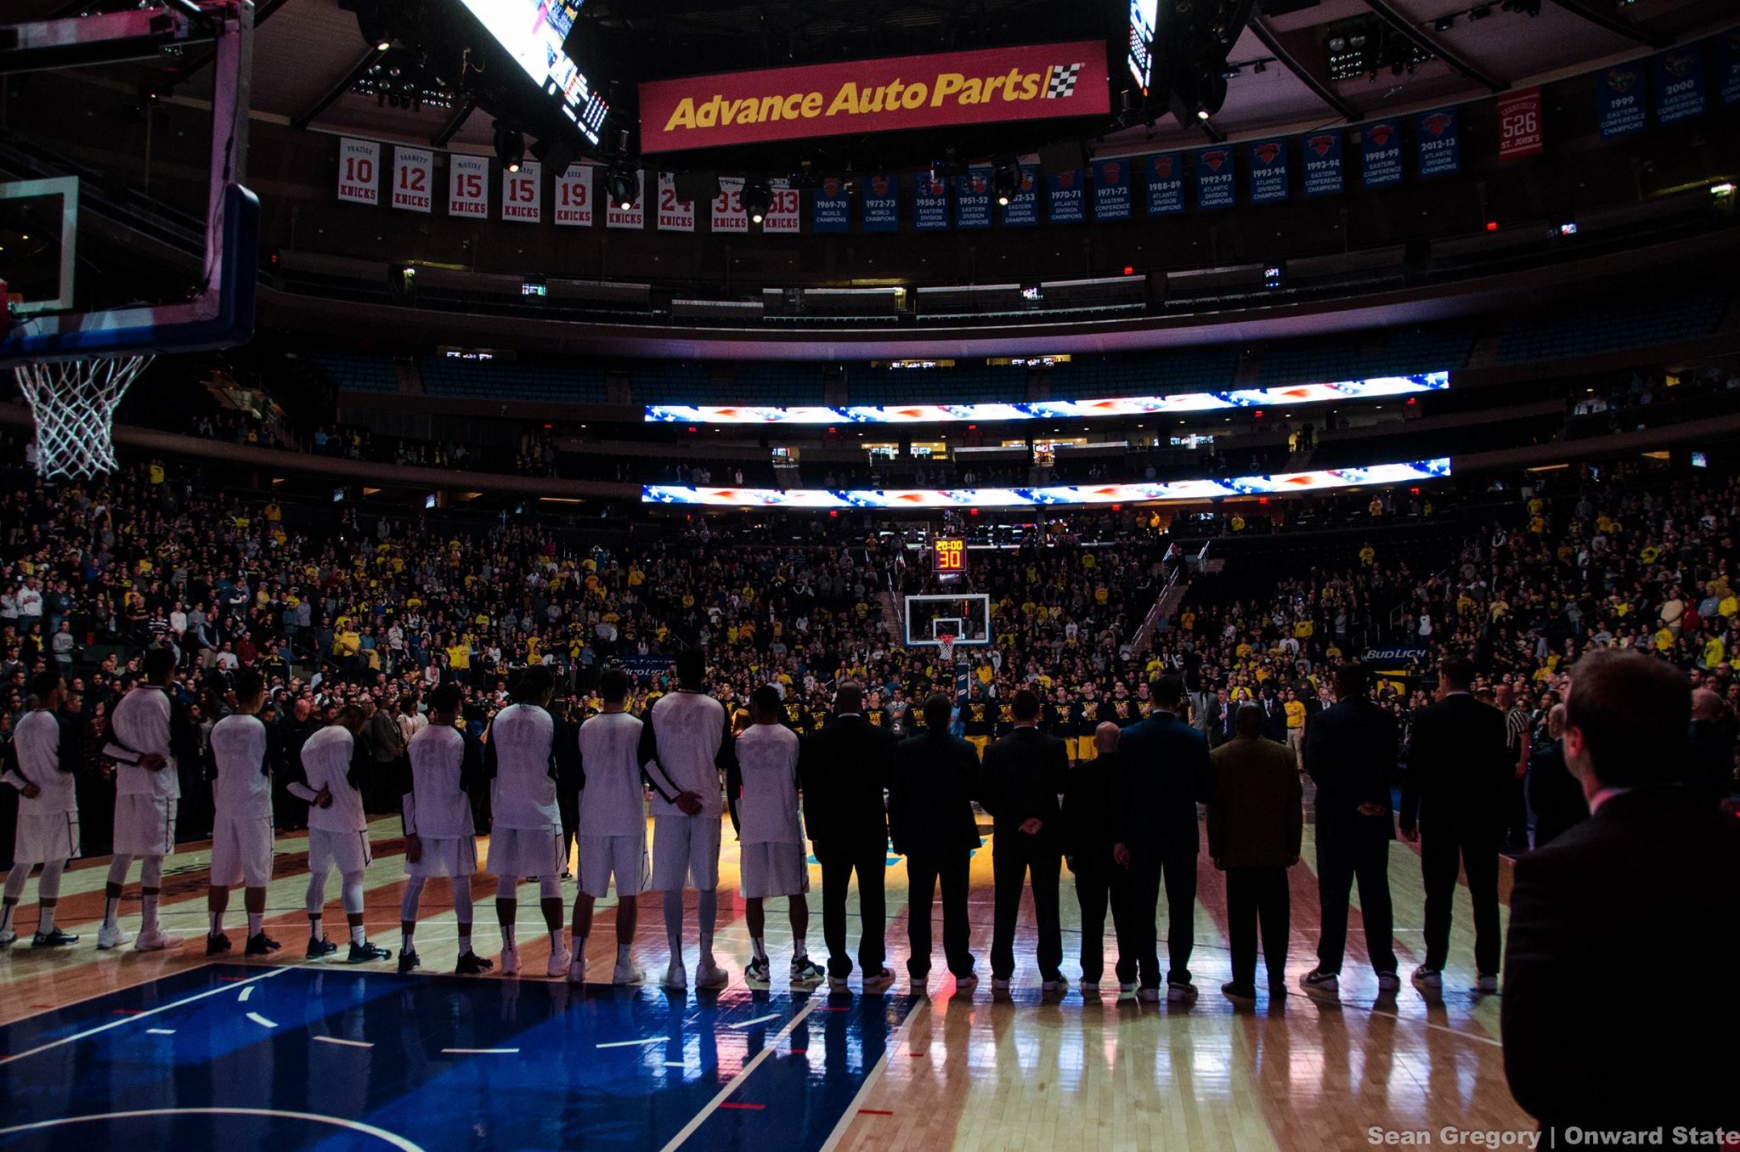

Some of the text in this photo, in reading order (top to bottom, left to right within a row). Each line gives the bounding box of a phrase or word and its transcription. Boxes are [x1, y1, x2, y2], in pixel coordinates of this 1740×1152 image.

[1666, 79, 1695, 95] 2000
[664, 68, 1041, 132] Advance Auto Parts
[1610, 95, 1635, 109] 1999
[1663, 91, 1697, 105] EASTERN
[1657, 96, 1705, 115] CONFERENCE
[1606, 107, 1639, 120] EASTERN
[1660, 105, 1703, 122] CHAMPIONS
[1503, 111, 1537, 138] 526
[1600, 112, 1646, 128] CONFERENCE
[1603, 121, 1644, 136] CHAMPIONS
[1421, 138, 1455, 151] 2012-13
[1514, 134, 1540, 146] JOHN'S
[1365, 148, 1399, 162] 1998-99
[1424, 149, 1453, 159] ATLANTIC
[1307, 159, 1340, 170] 1993-94
[1369, 160, 1396, 170] EASTERN
[1426, 157, 1452, 166] DIVISION
[346, 157, 372, 183] 10
[1253, 166, 1285, 178] 1993-94
[1311, 170, 1336, 178] EASTERN
[1364, 166, 1402, 178] CONFERENCE
[1421, 163, 1457, 174] CHAMPIONS
[400, 165, 426, 192] 12
[1200, 174, 1232, 185] 1992-93
[1256, 178, 1282, 186] ATLANTIC
[1305, 176, 1343, 186] CONFERENCE
[1366, 174, 1400, 184] CHAMPIONS
[457, 174, 482, 198] 15
[509, 178, 534, 202] 15
[1149, 181, 1181, 191] 1988-89
[1308, 184, 1341, 192] CHAMPIONS
[341, 185, 376, 200] KNICKS
[562, 183, 586, 206] 19
[1051, 190, 1081, 199] 1970-71
[1097, 187, 1128, 197] 1971-72
[1152, 191, 1178, 199] ATLANTIC
[1205, 191, 1228, 199] DIVISION
[1253, 191, 1286, 199] CHAMPIONS
[395, 193, 429, 207] KNICKS
[716, 191, 745, 213] 33
[816, 200, 847, 209] 1969-70
[866, 199, 896, 208] 1972-73
[916, 198, 946, 207] 1950-51
[959, 197, 989, 205] 1951-52
[1201, 197, 1233, 206] CHAMPIONS
[451, 201, 486, 213] KNICKS
[505, 206, 538, 218] KNICKS
[1095, 203, 1130, 211] CONFERENCE
[1150, 204, 1182, 212] CHAMPIONS
[557, 210, 590, 221] KNICKS
[609, 213, 642, 224] KNICKS
[1097, 210, 1129, 218] CHAMPIONS
[660, 216, 692, 227] KNICKS
[713, 218, 746, 228] KNICKS
[765, 218, 798, 228] KNICKS
[935, 540, 963, 551] 20:00
[939, 551, 960, 568] 30
[1367, 649, 1426, 659] BUD LIGH
